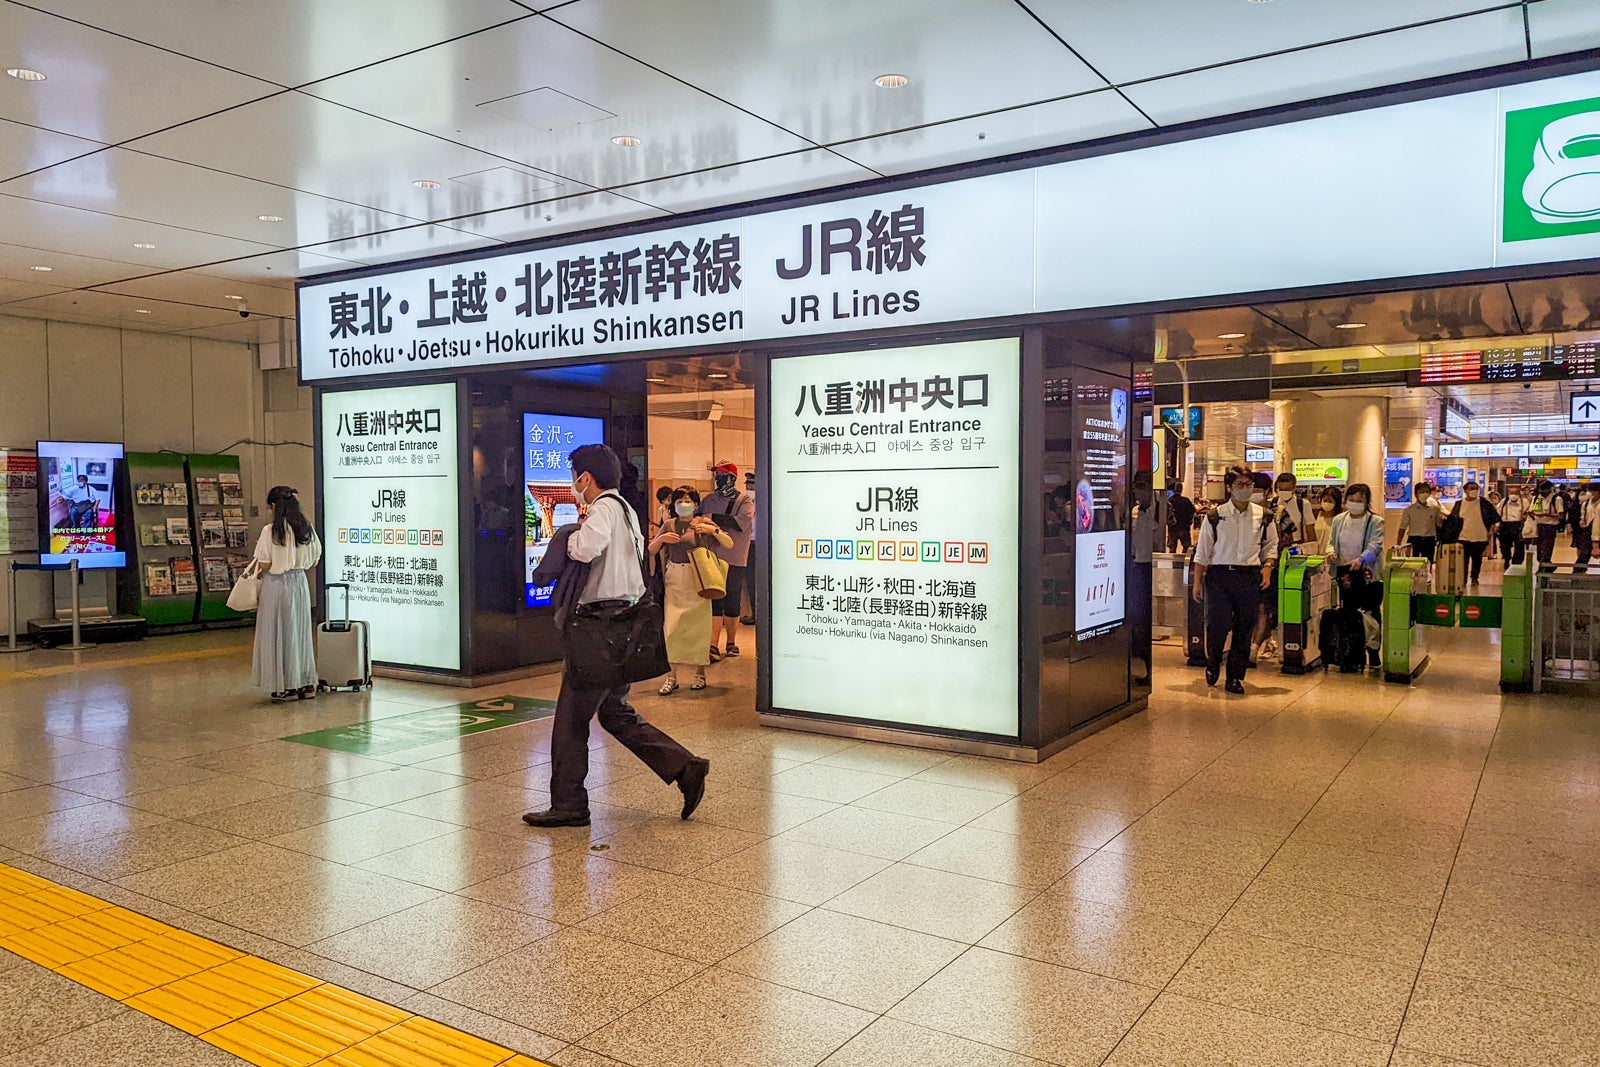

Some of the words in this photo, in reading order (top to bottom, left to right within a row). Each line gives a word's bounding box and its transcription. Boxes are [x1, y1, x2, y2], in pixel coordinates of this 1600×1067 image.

[775, 204, 927, 280] JR線
[781, 294, 820, 325] JR
[833, 289, 920, 320] Lines
[593, 309, 743, 344] Shinkansen
[795, 373, 989, 418] 八重洲中央口
[336, 408, 441, 437] 八重洲中央口
[802, 424, 845, 438] Yaesu
[849, 420, 903, 436] Central
[909, 418, 982, 434] Entrance
[529, 423, 574, 445] 金沢で
[341, 442, 365, 453] Yaesu
[367, 440, 397, 452] Central
[399, 440, 438, 451] Entrance
[797, 441, 876, 456] 八重洲中央入口
[887, 439, 924, 453] 야에스
[929, 437, 954, 452] 중앙
[960, 436, 986, 451] 입구
[371, 489, 407, 509] JR線
[856, 487, 919, 513] JR線
[371, 512, 383, 523] JR
[385, 512, 406, 523] Lines
[856, 517, 875, 532] JR
[880, 518, 918, 532] Lines
[805, 574, 977, 598] 東北・山形・秋田・北海道
[414, 598, 445, 608] Shinkansen
[869, 629, 886, 642] (via
[888, 631, 928, 645] Nagano)
[930, 634, 988, 649] Shinkansen
